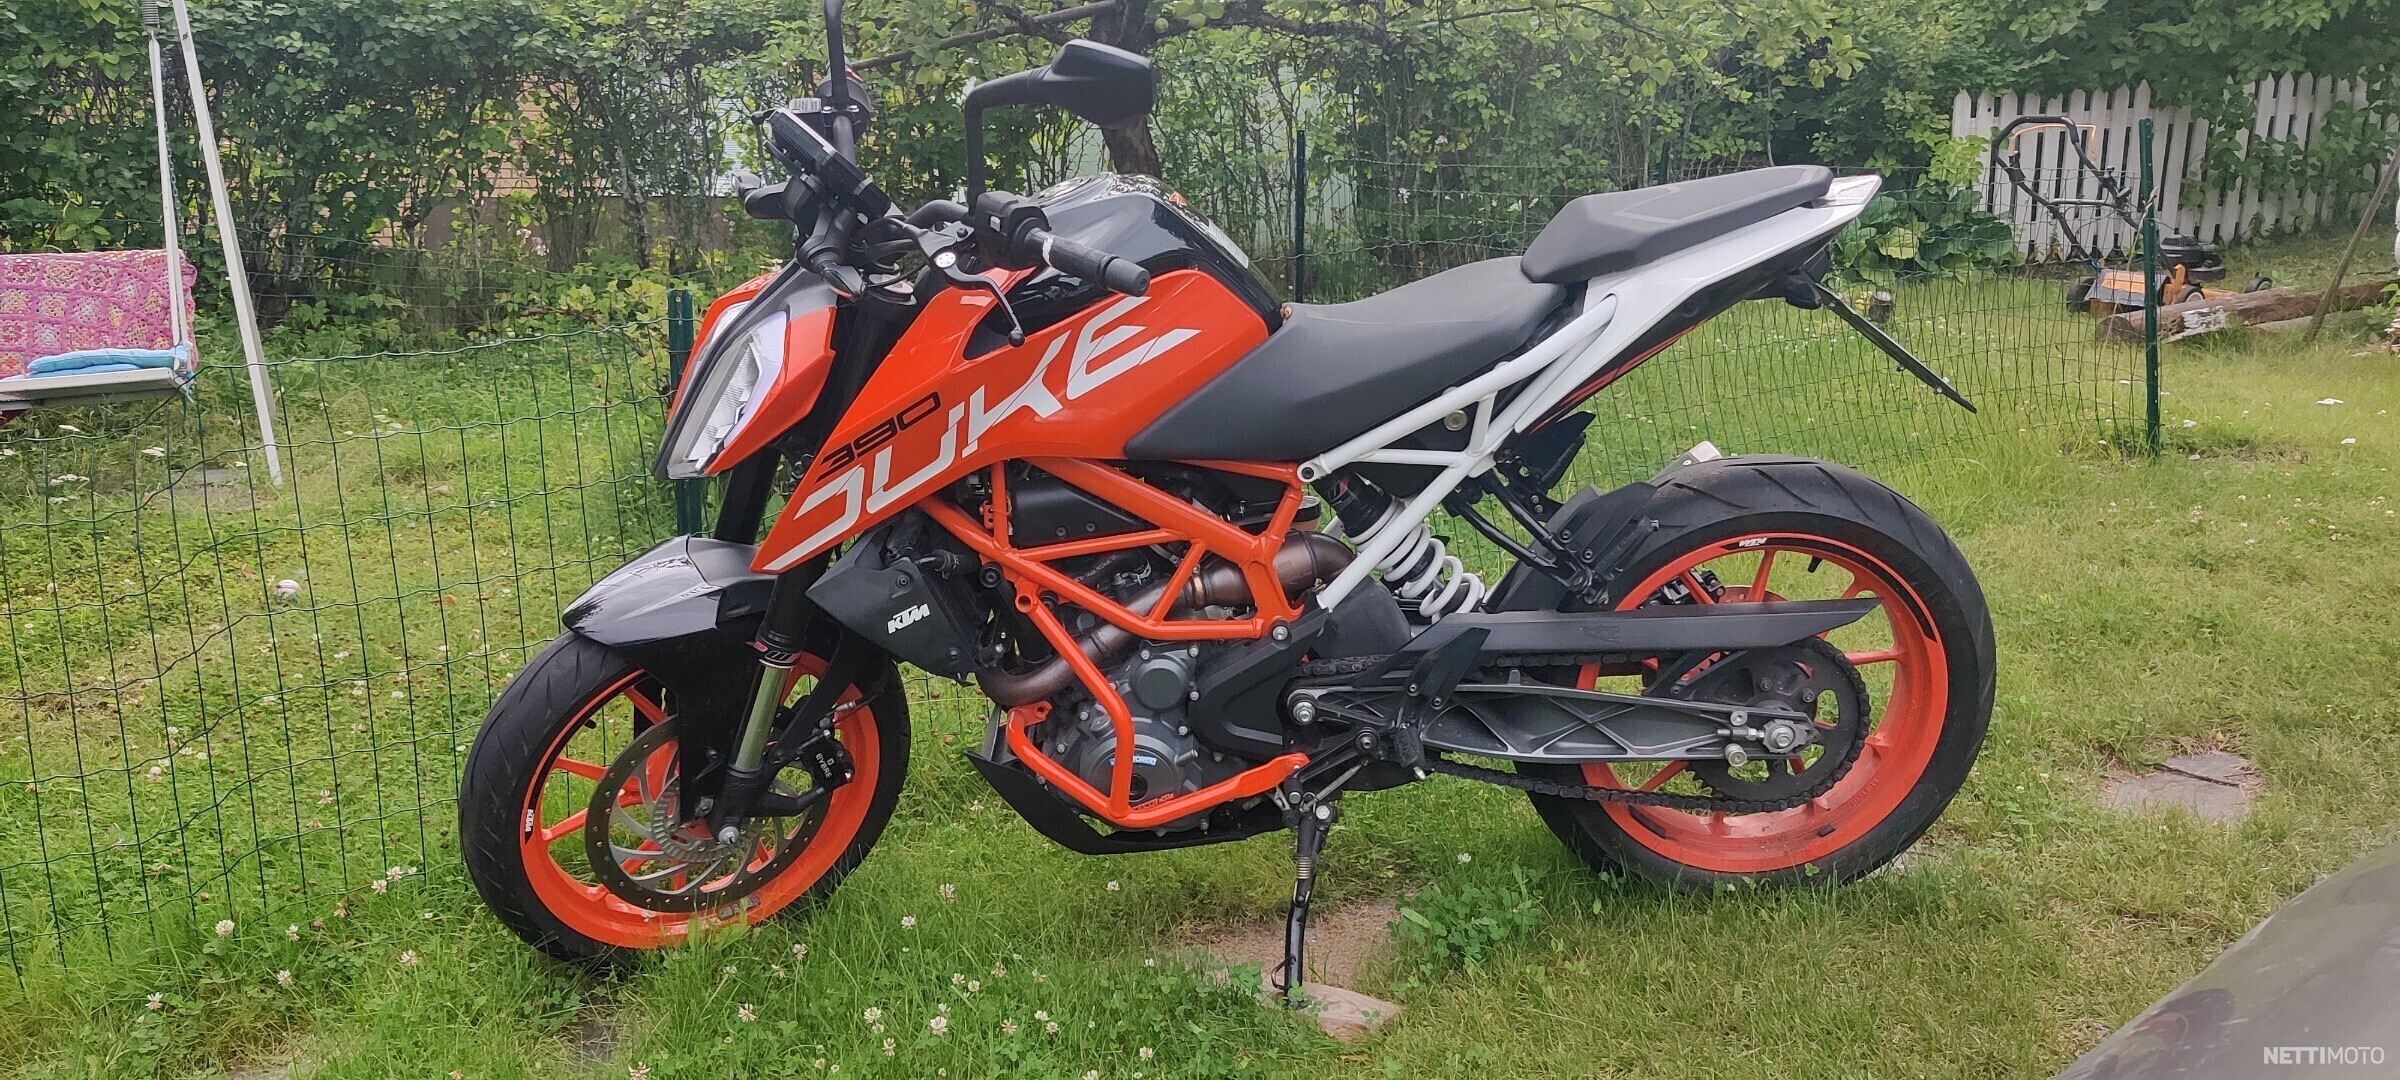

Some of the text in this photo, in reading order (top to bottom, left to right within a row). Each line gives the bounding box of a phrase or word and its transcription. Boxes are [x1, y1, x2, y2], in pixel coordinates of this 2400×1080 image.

[762, 296, 1202, 571] DUKE
[816, 391, 941, 483] 390
[887, 603, 931, 635] KTM
[815, 752, 833, 779] BYBRE
